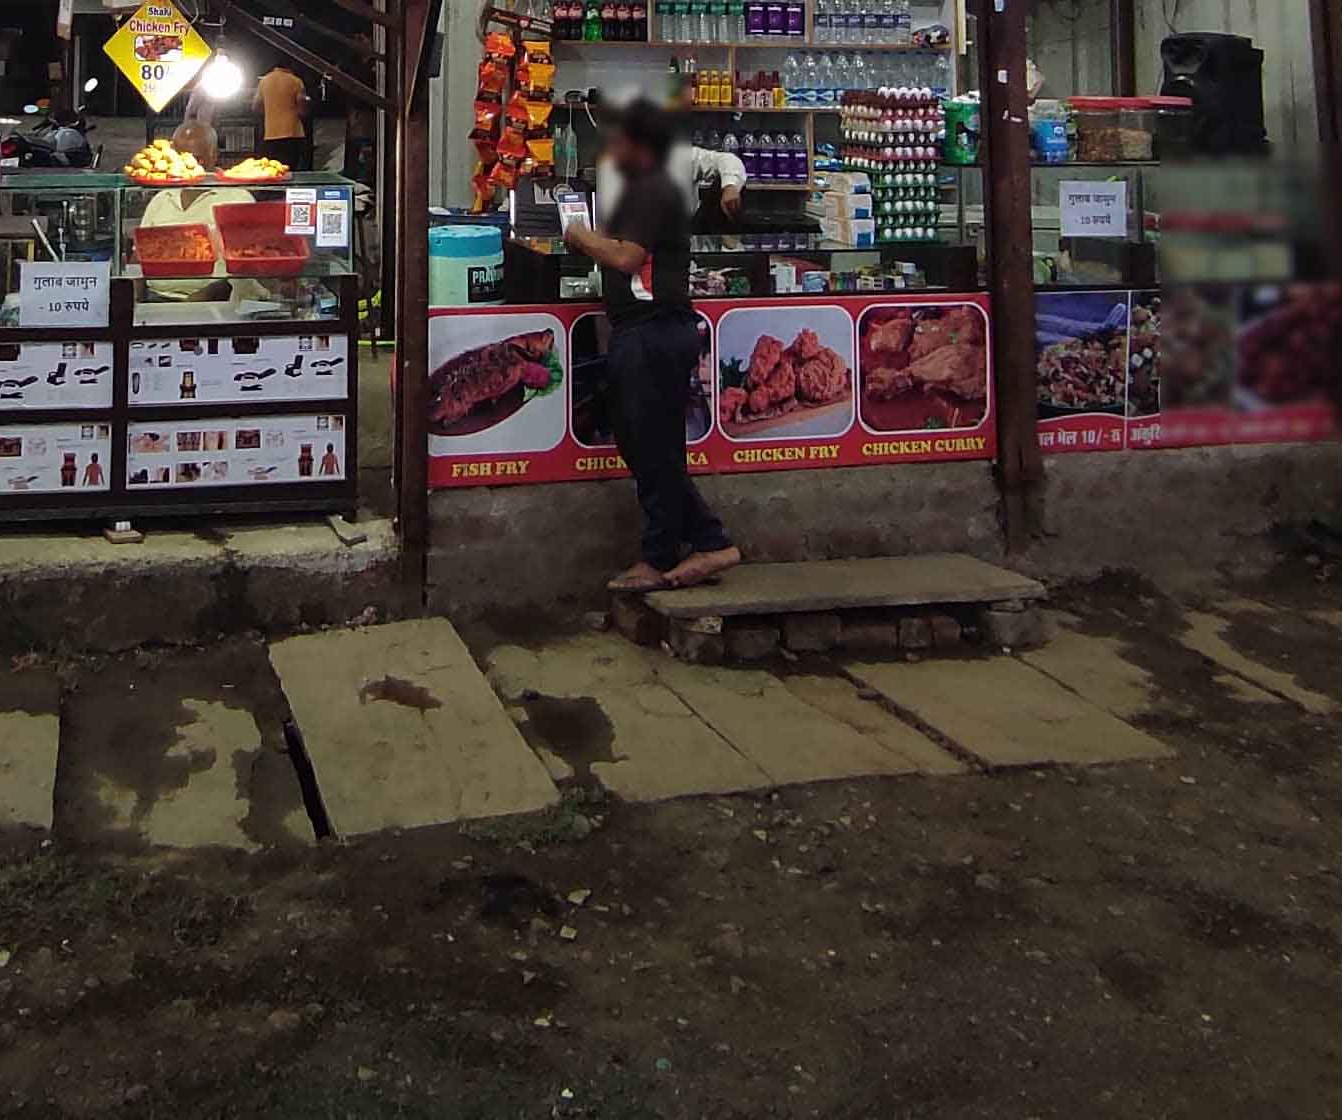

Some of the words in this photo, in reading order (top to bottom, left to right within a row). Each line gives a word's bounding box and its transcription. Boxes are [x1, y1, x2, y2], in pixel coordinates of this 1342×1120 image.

[129, 20, 170, 33] Chicken
[174, 21, 189, 35] Fry
[49, 302, 62, 312] 10
[733, 447, 806, 463] CHICKEN
[809, 444, 841, 460] FRY
[862, 439, 931, 456] CHICKEN
[934, 437, 986, 453] CURRY
[451, 462, 492, 478] FISH
[495, 459, 530, 476] FRY
